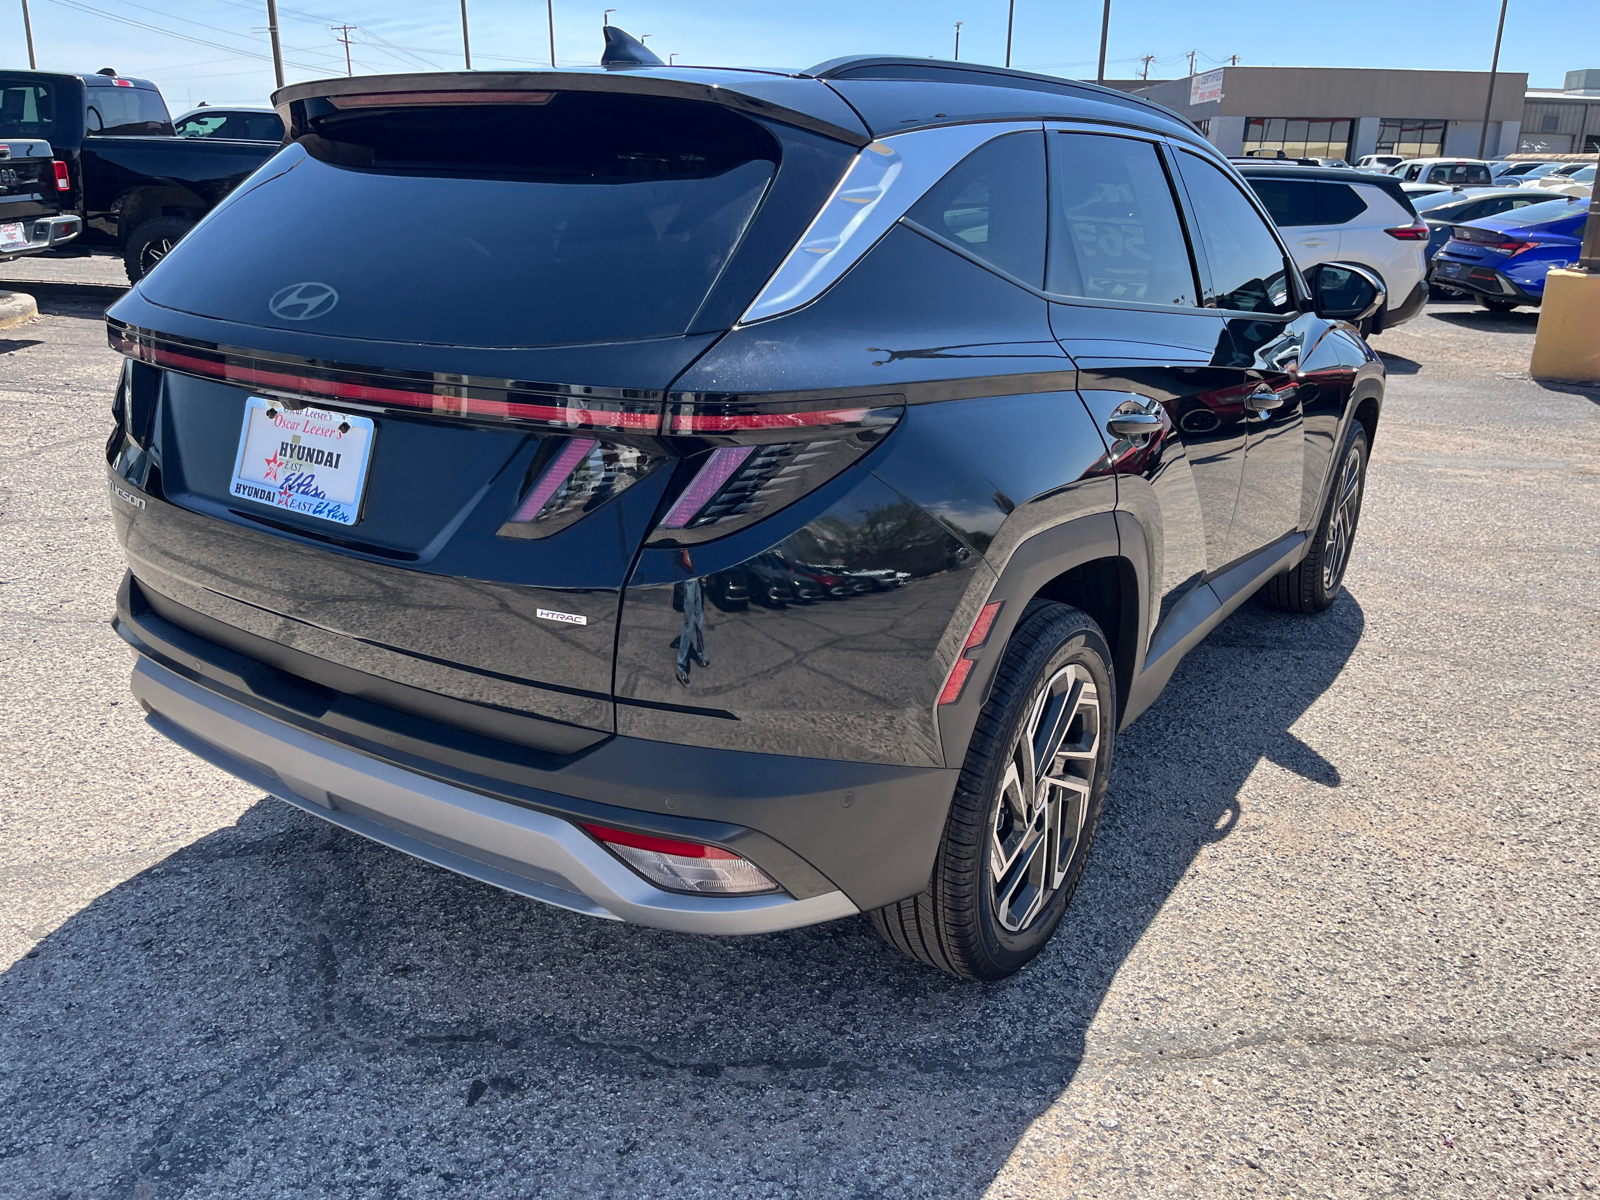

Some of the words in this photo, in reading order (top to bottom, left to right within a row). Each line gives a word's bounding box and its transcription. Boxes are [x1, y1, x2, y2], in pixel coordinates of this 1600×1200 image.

[274, 413, 300, 431] Oscar
[302, 420, 342, 440] Leeser's
[279, 441, 342, 470] HYUNDAI
[284, 460, 304, 473] EAST
[279, 472, 304, 491] El
[296, 474, 326, 500] Paso
[234, 483, 276, 503] HYUNDAI
[289, 498, 314, 512] EAST
[312, 501, 330, 516] El
[327, 504, 350, 523] Paso
[540, 611, 583, 624] HTRAC
[1003, 676, 1045, 772] MICHELIN
